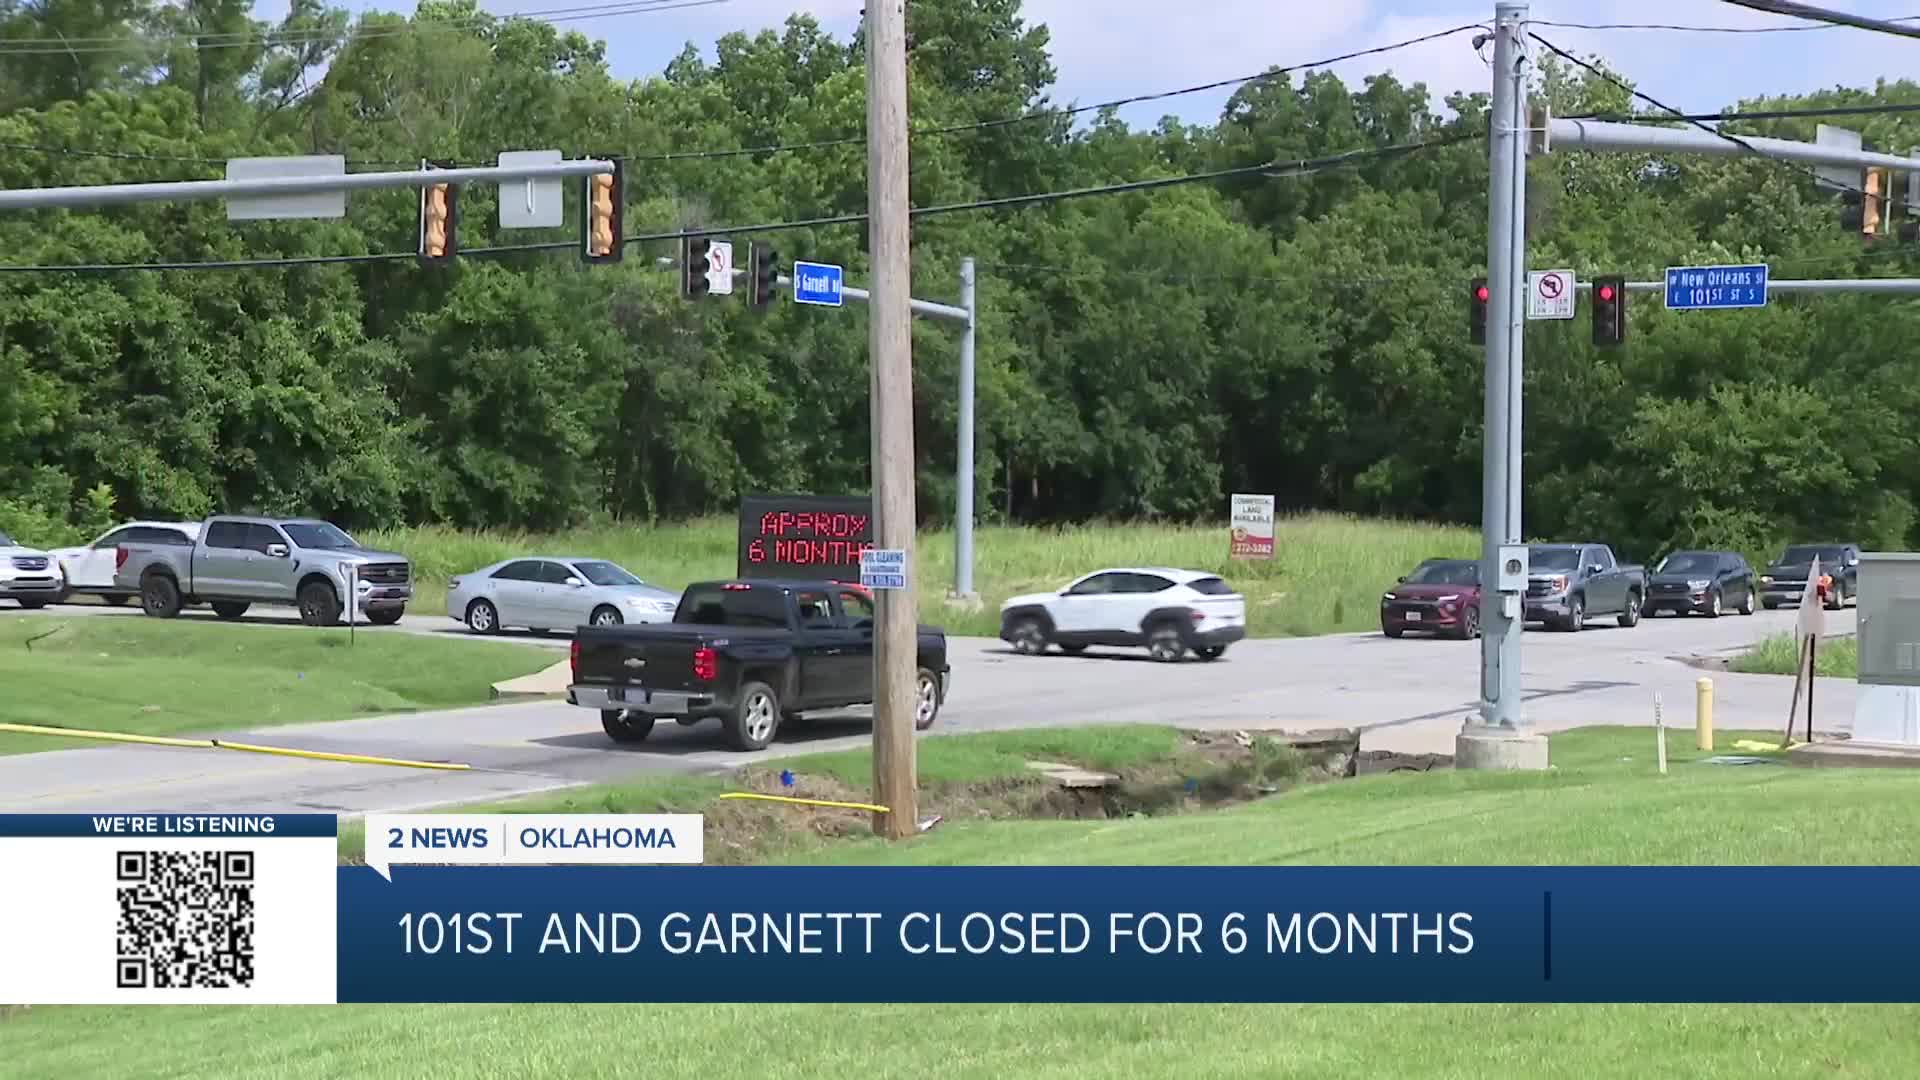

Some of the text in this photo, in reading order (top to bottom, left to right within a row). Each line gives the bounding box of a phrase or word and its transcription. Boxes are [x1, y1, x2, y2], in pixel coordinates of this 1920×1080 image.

[1681, 272, 1705, 287] New
[1708, 270, 1751, 286] Orleans
[1689, 288, 1723, 305] 101ST
[1749, 288, 1756, 300] S
[761, 511, 868, 537] APPROX
[748, 539, 766, 563] 6
